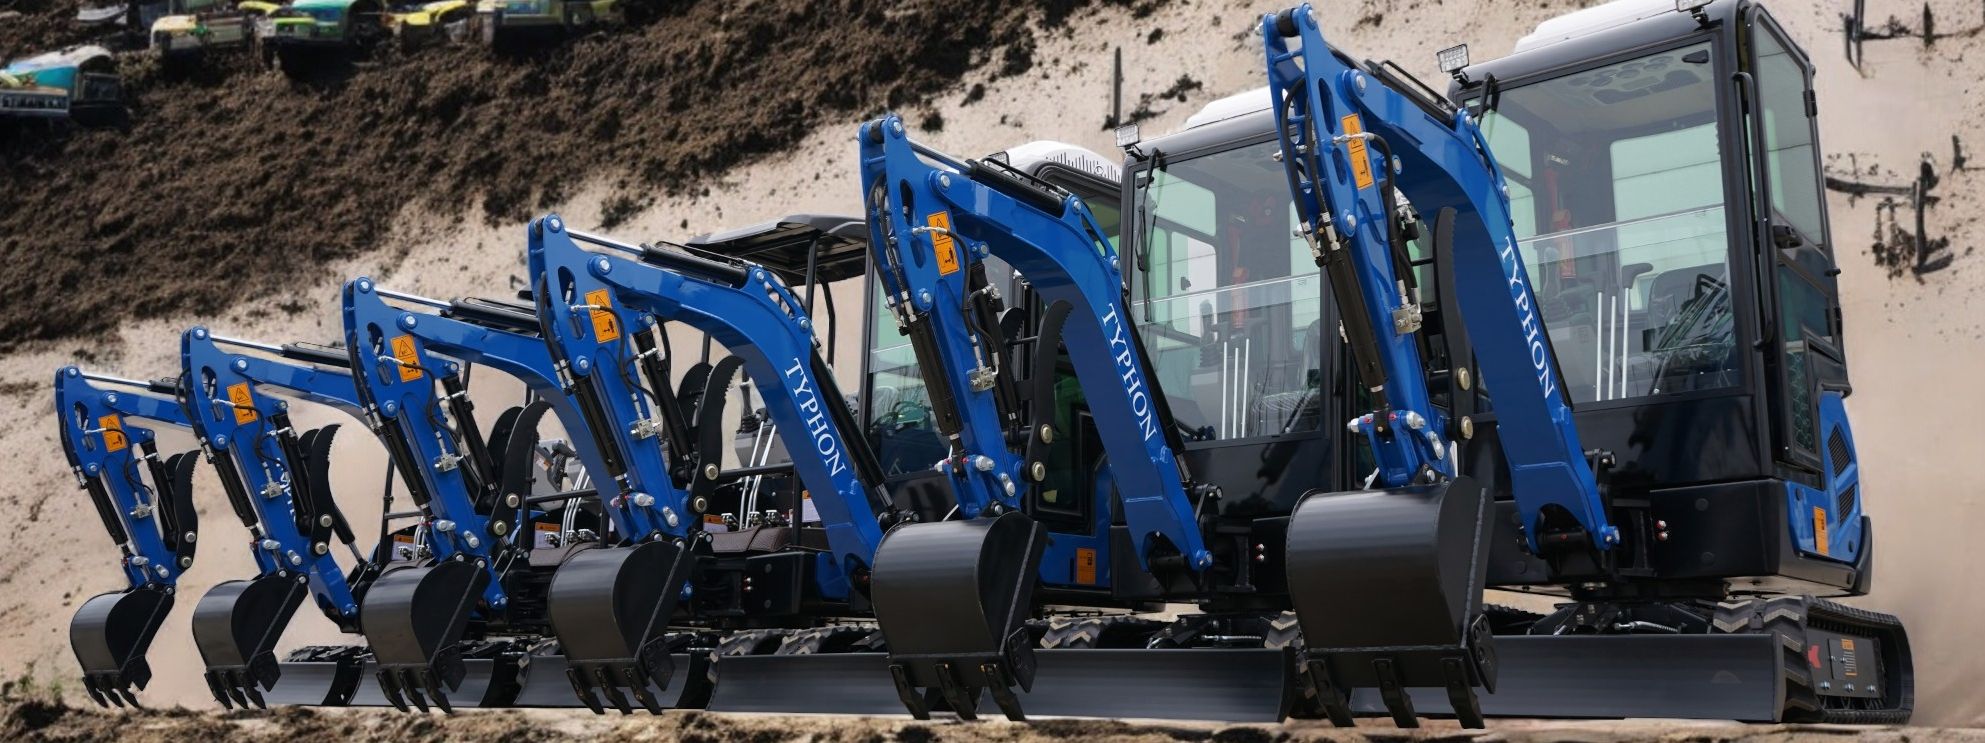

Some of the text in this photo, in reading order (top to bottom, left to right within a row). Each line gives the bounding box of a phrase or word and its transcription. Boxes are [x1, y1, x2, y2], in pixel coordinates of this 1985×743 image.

[1102, 302, 1157, 441] TYPHON
[1501, 235, 1555, 399] TYPHON
[785, 357, 846, 477] TYPHON
